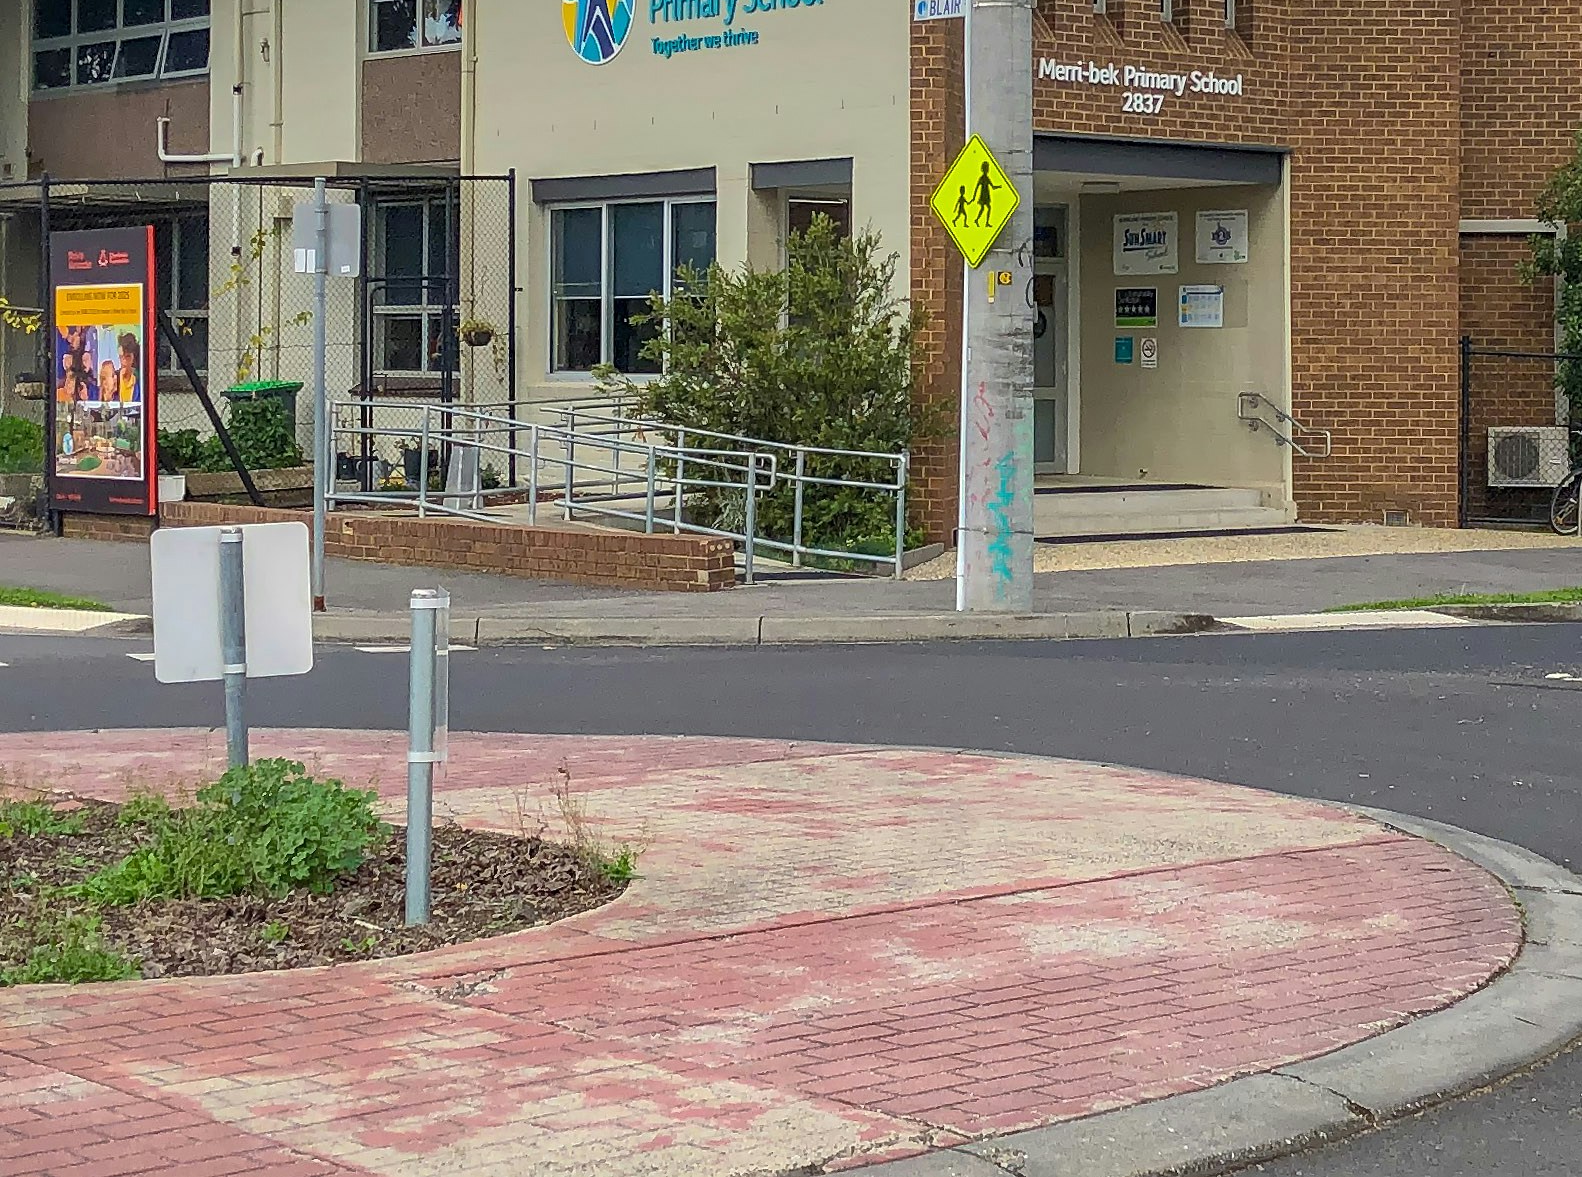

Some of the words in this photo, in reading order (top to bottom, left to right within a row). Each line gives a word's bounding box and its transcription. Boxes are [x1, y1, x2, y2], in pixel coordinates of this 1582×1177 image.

[651, 34, 702, 59] Together
[704, 35, 722, 49] we
[723, 28, 760, 48] thrive
[1038, 57, 1120, 85] Merri-bek
[1123, 64, 1187, 97] Primary
[1189, 70, 1243, 96] School
[1122, 91, 1164, 114] 2837
